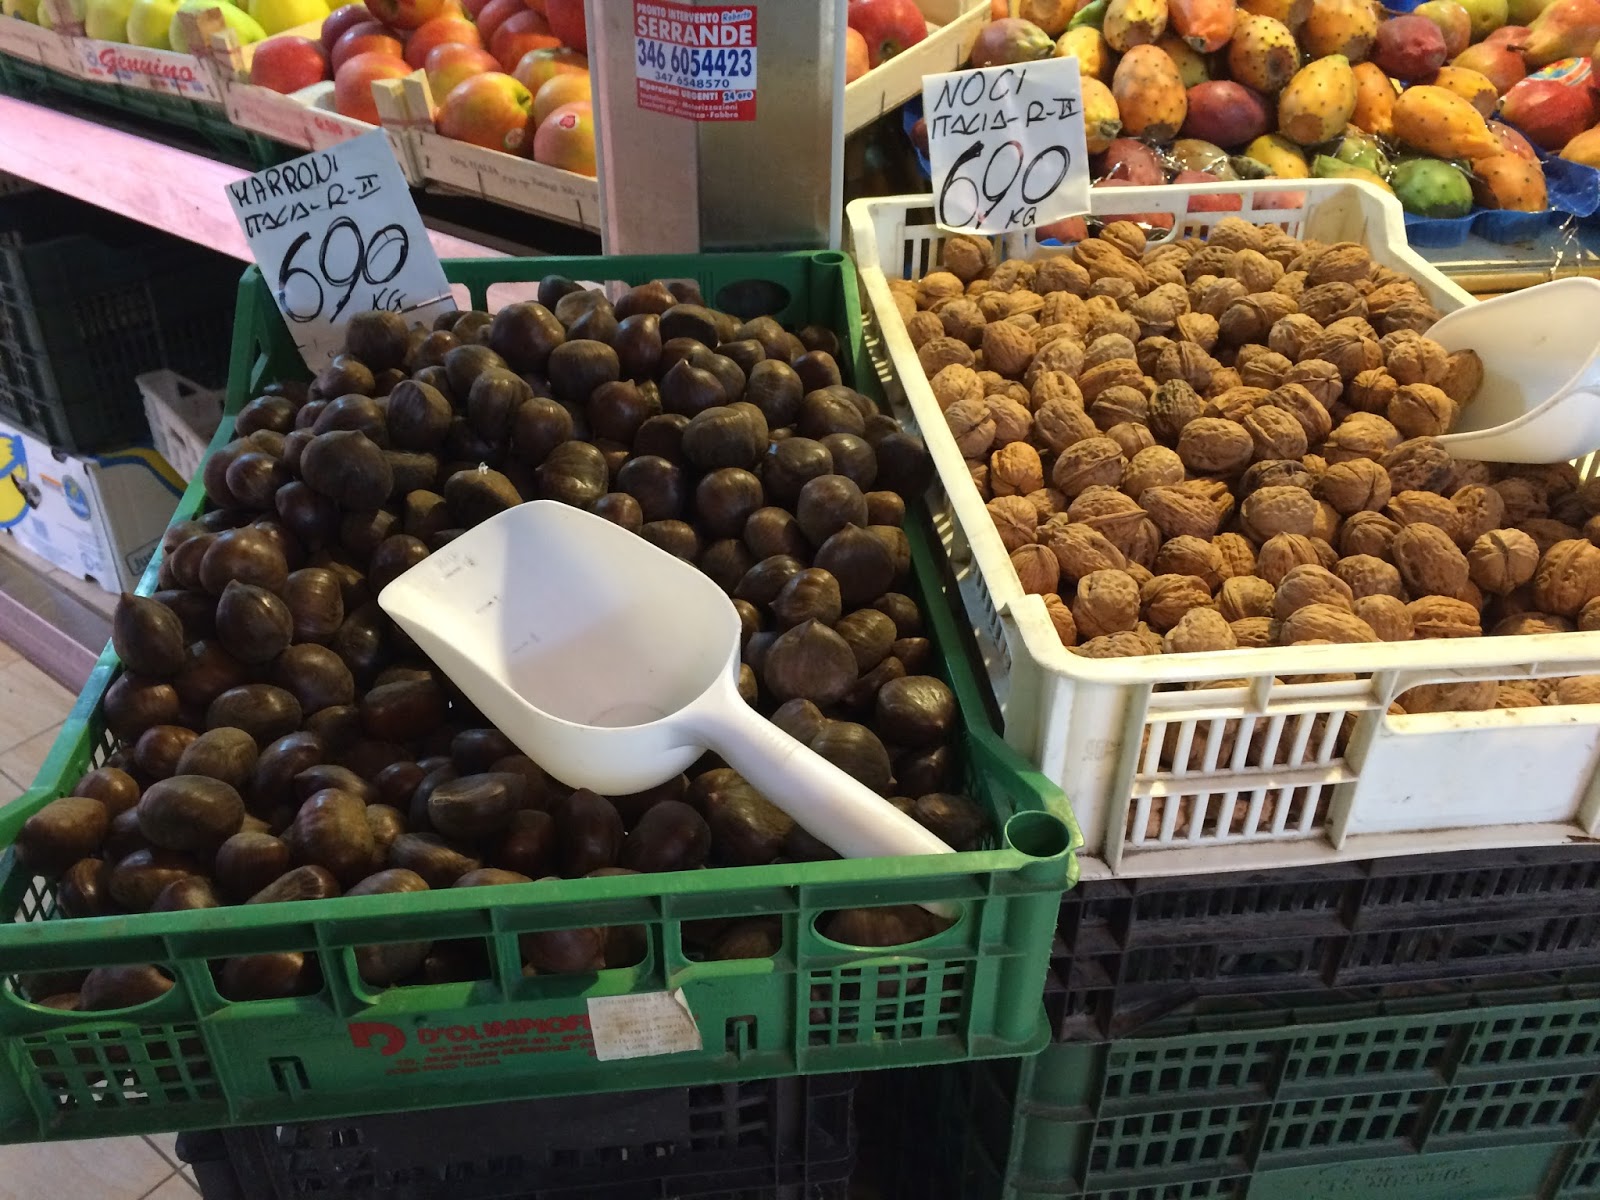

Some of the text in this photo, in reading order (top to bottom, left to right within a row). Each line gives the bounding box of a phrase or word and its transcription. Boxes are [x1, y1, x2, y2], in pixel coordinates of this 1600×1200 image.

[636, 3, 666, 17] PRONTO
[668, 9, 718, 23] INTERVENTO
[637, 15, 752, 46] SERRANDE
[99, 48, 196, 82] Genuino
[637, 38, 752, 77] 346 6054423
[655, 71, 730, 89] 347 6548570
[933, 69, 1027, 112] NOCI
[723, 92, 735, 101] 24
[230, 153, 339, 208] MARRONI
[1005, 206, 1037, 229] KG
[371, 287, 407, 312] KG
